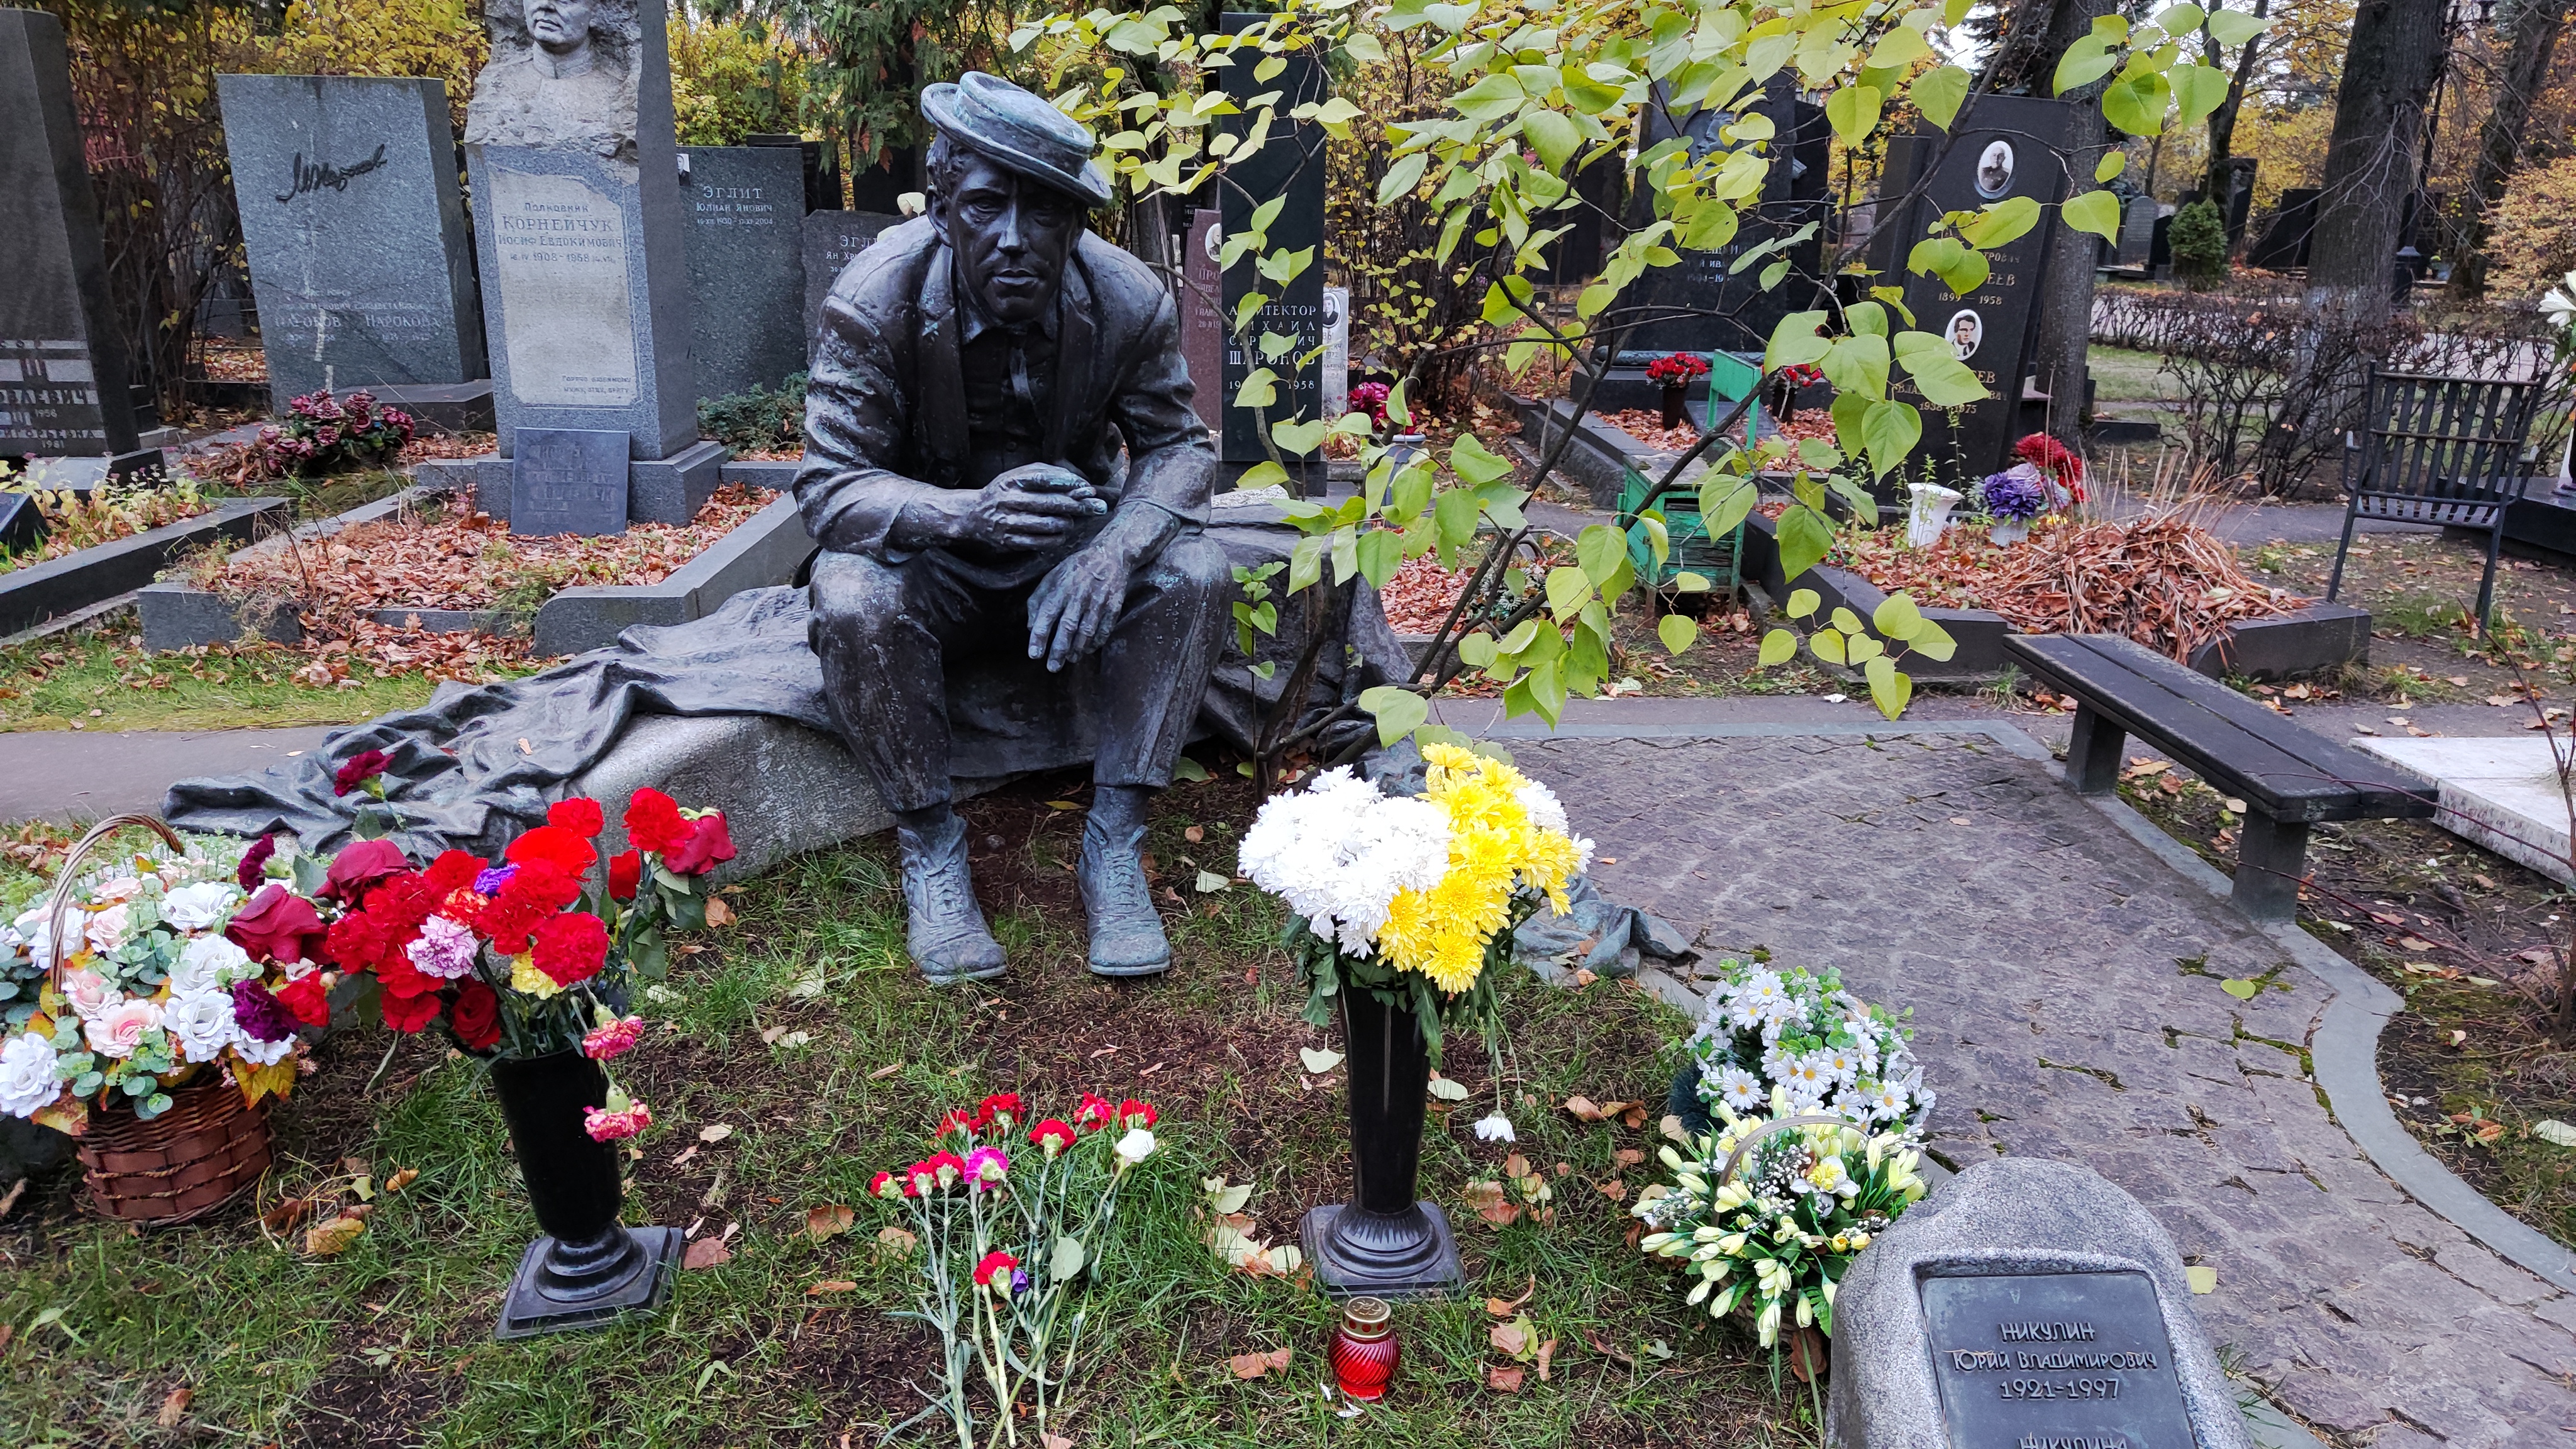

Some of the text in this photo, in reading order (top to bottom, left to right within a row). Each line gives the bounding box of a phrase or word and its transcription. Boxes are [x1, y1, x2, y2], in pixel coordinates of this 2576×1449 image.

[703, 186, 763, 199] ЭГЛИТ
[696, 202, 773, 212] ЮЛИАН ЯНОВИЧ
[502, 215, 614, 231] КОРНЕЙЧУК
[716, 217, 733, 225] 1930
[826, 251, 839, 260] ЯН
[1938, 292, 1962, 302] 1899
[1979, 295, 2002, 306] 1958
[1228, 305, 1316, 316] АИТЕКТОР
[42, 440, 65, 448] 1981
[1999, 1321, 2096, 1343] НИКУЛИН
[1952, 1350, 2159, 1371] ЮРИЙ ВЛАДИМИРОВИЧ
[2000, 1378, 2120, 1400] 1921-1997
